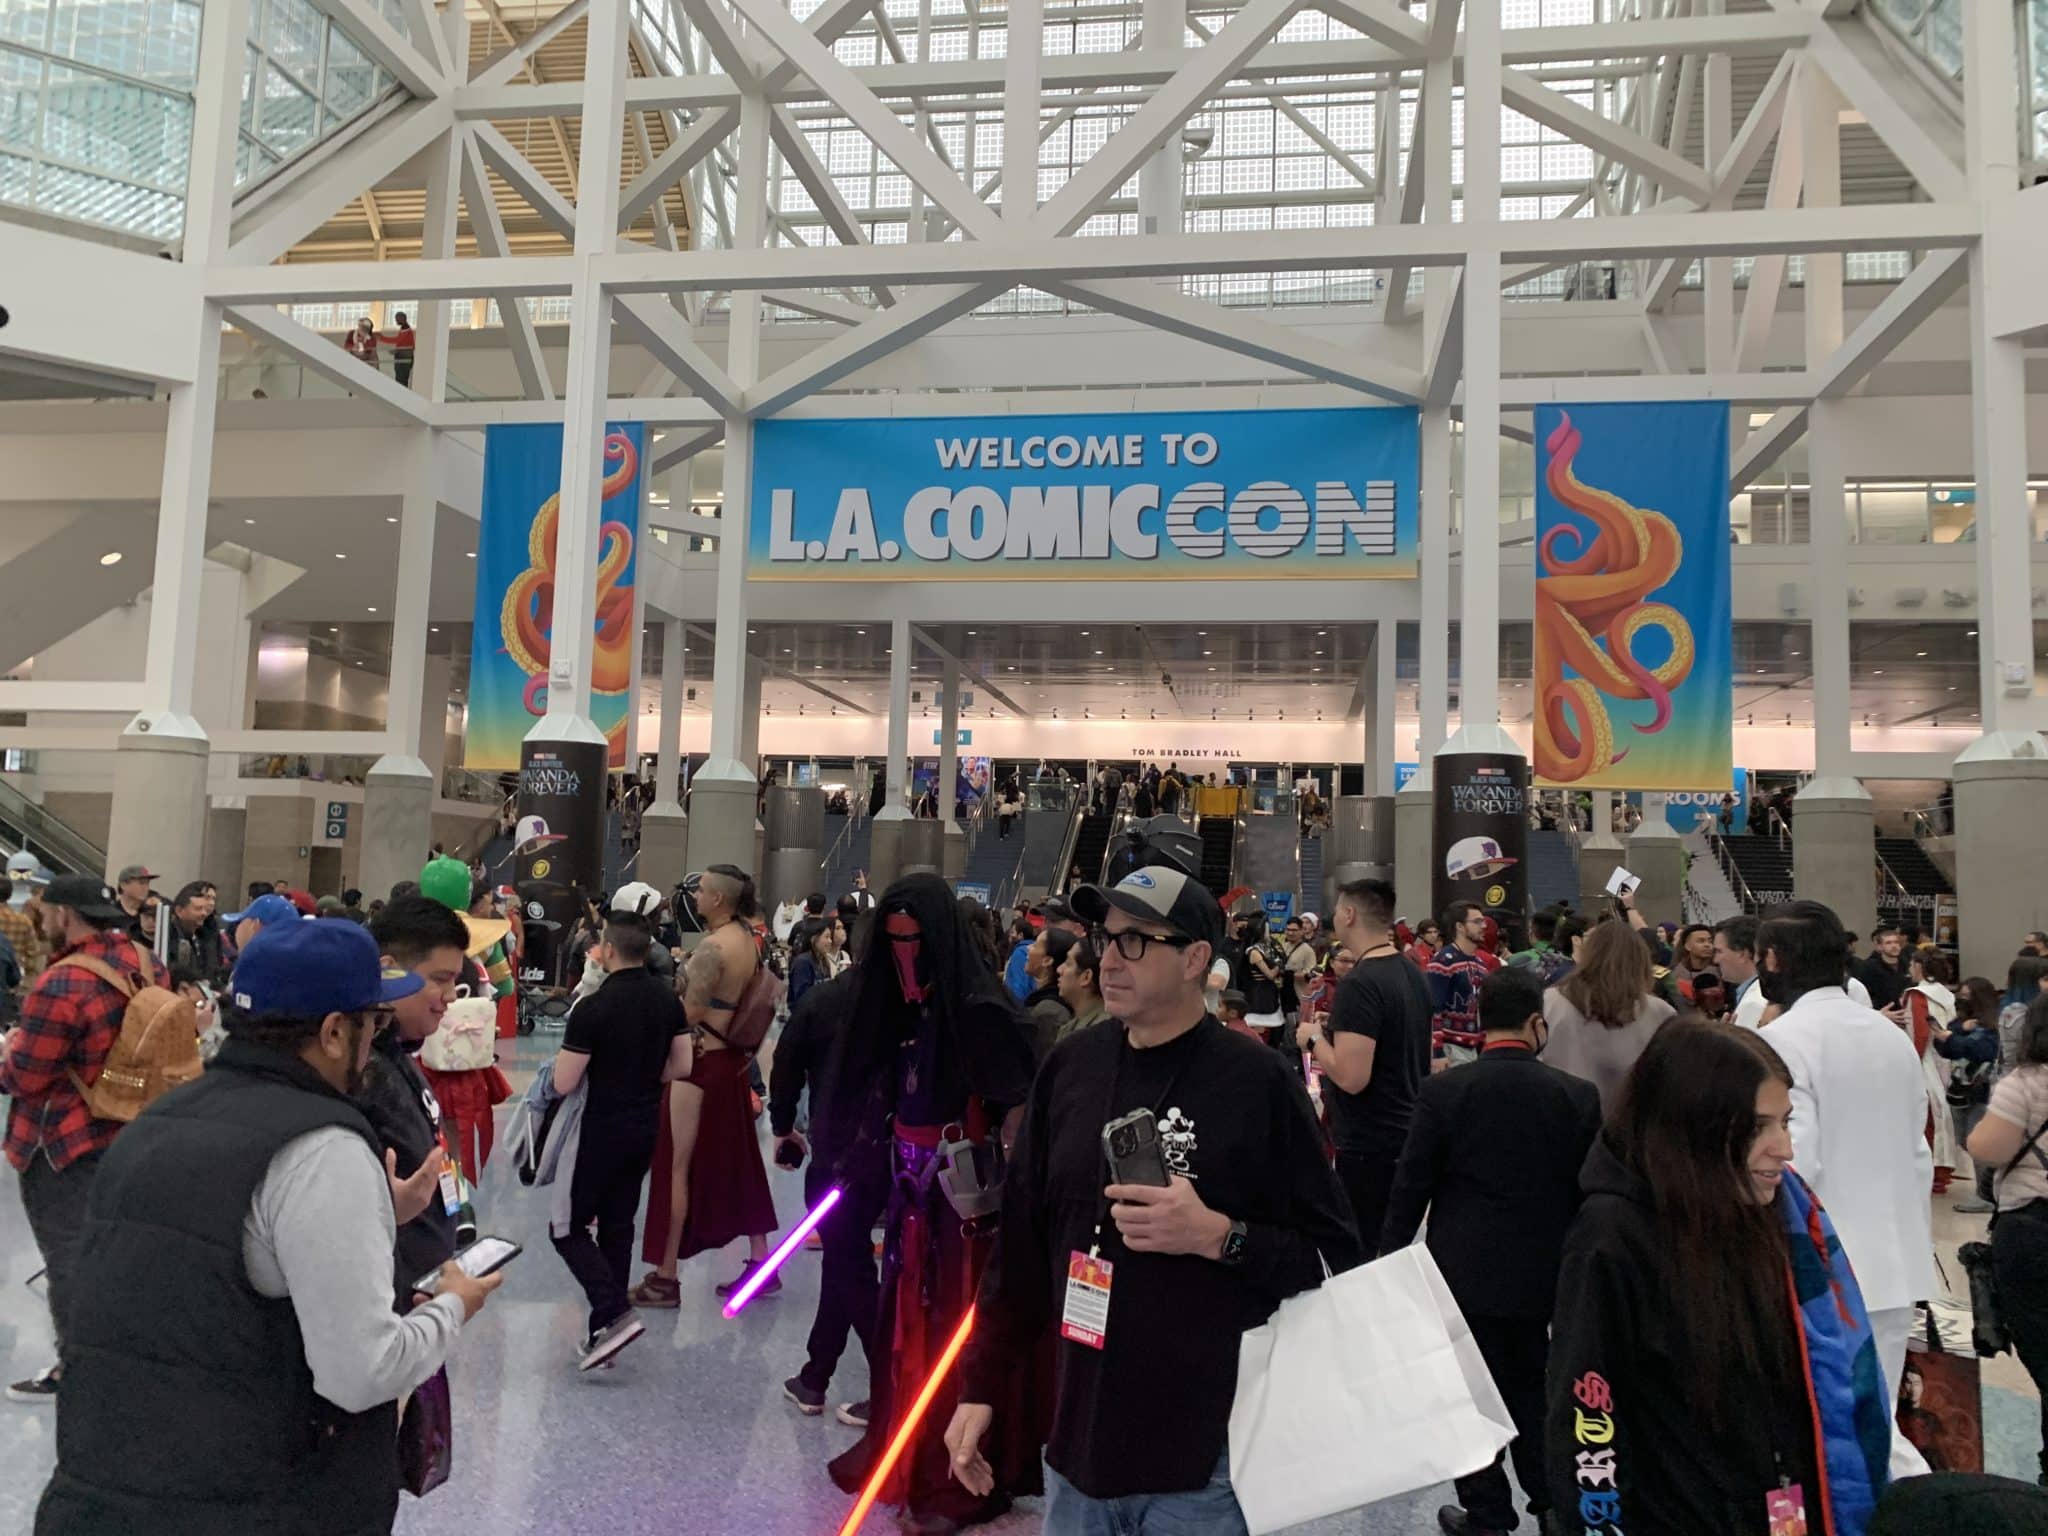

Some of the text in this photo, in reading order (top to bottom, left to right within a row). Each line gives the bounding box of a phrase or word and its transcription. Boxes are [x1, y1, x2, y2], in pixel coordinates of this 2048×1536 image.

[935, 432, 1218, 468] WELCOME TO
[769, 480, 1395, 561] L.A. COMIC CON
[1132, 748, 1242, 758] TOM BRADLEY HALL
[1450, 784, 1523, 800] WAKANDA
[1453, 799, 1523, 815] FOREVER
[519, 966, 545, 980] Lids
[1573, 1370, 1625, 1536] ARTS
